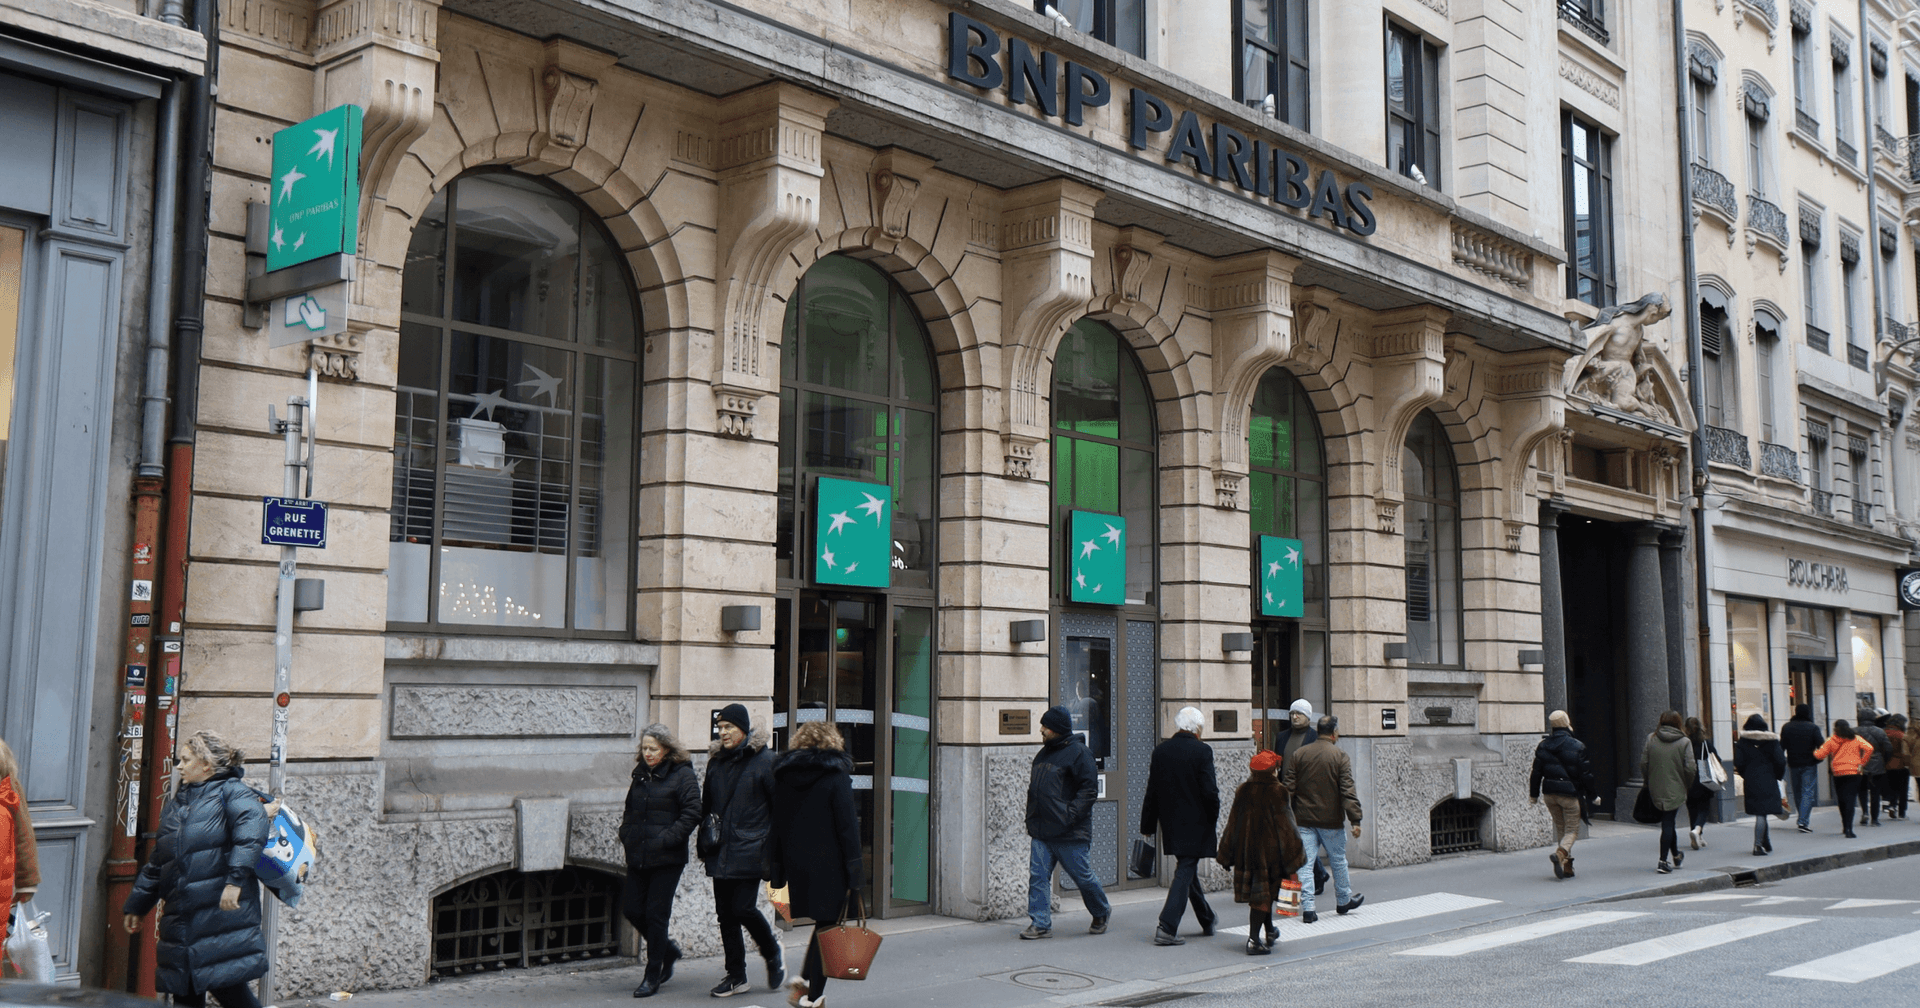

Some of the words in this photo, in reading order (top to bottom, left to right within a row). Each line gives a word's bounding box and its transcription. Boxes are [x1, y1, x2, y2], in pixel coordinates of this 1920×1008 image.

[948, 11, 1111, 127] BNP
[1129, 87, 1377, 237] PARIBAS
[289, 210, 305, 223] BNP
[306, 198, 339, 217] PARIBAS
[284, 512, 307, 523] RUE
[269, 526, 321, 539] GRENETTE
[1787, 558, 1849, 592] BOUCHARA
